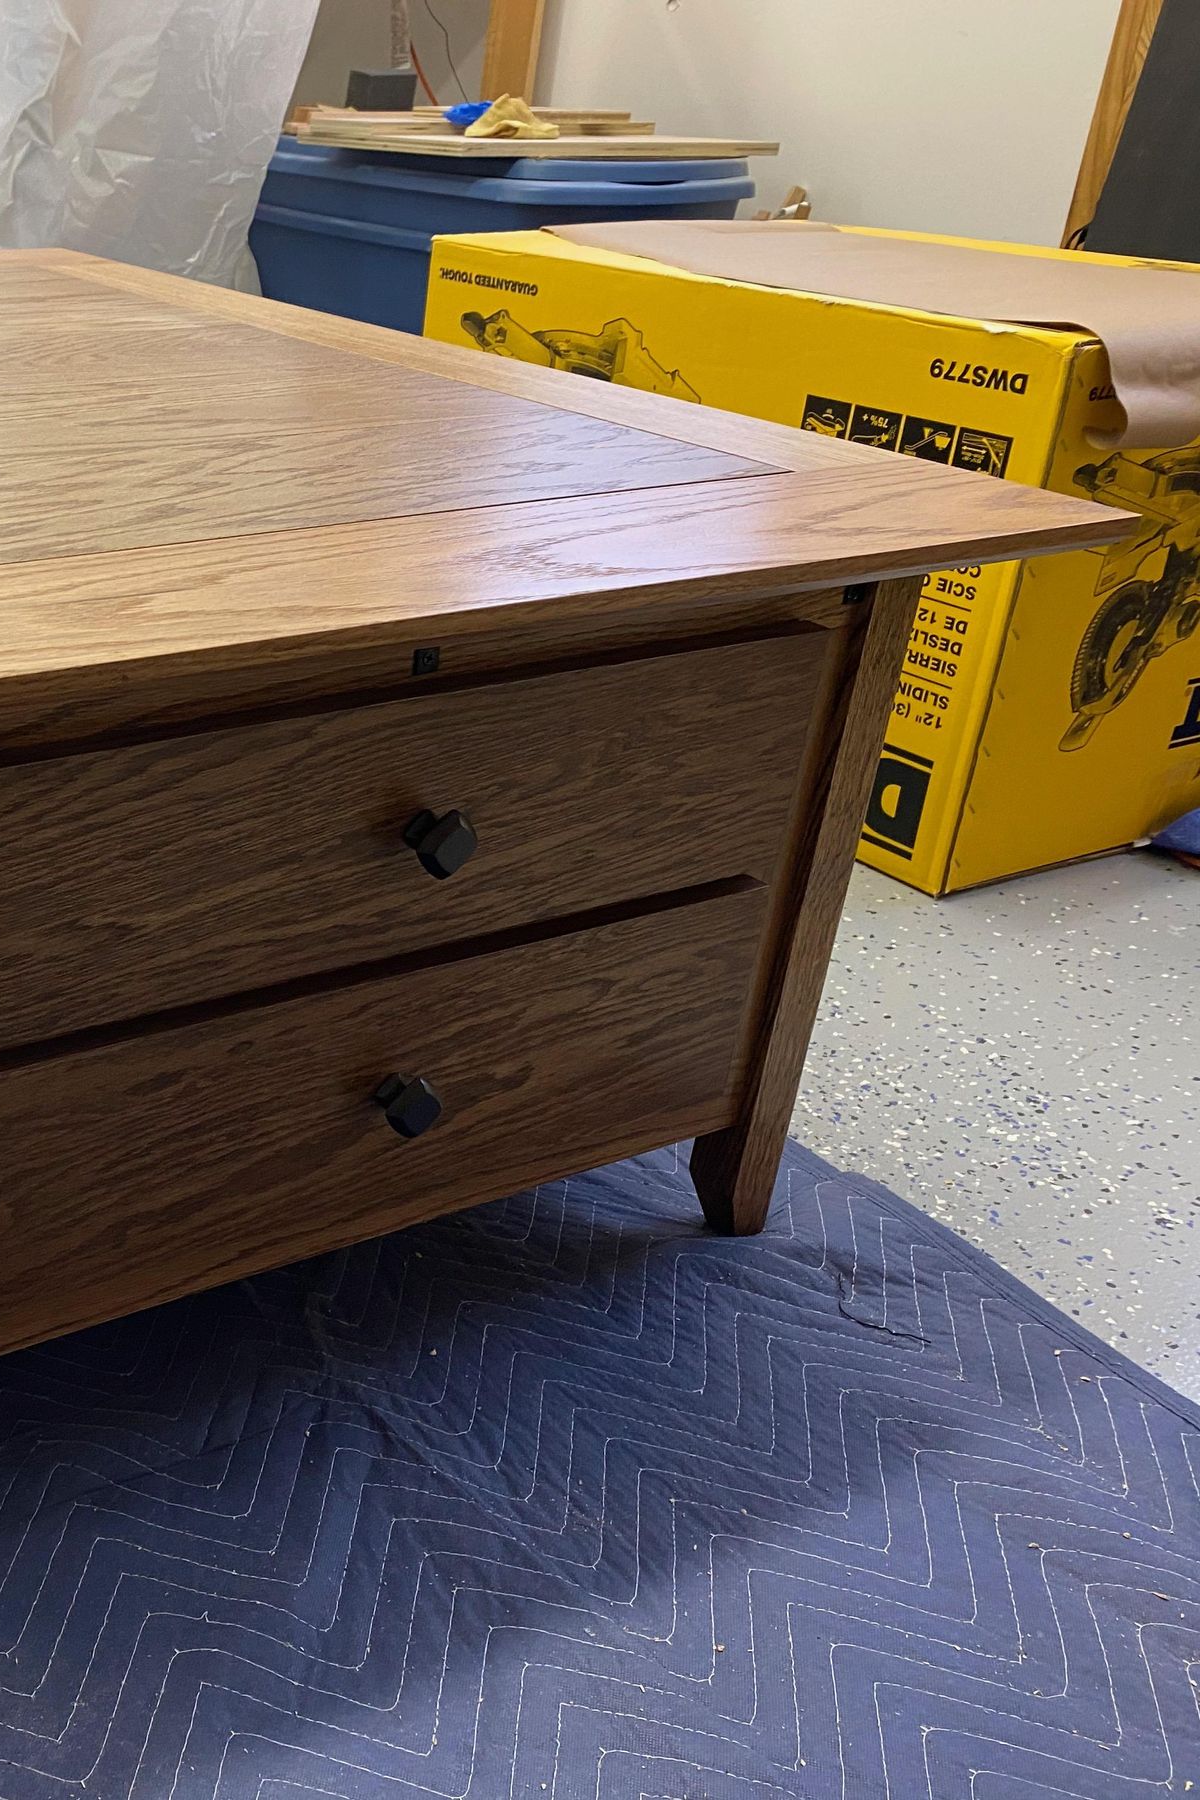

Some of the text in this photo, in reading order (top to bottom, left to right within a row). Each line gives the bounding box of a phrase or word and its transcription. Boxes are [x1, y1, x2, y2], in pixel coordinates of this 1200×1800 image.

[474, 274, 538, 296] GUARANTEED
[930, 358, 1029, 395] DWS779
[870, 414, 888, 428] 75%
[936, 578, 976, 600] SCIE
[918, 608, 968, 634] DE 12
[906, 650, 958, 677] SIERR
[915, 712, 942, 729] 12"
